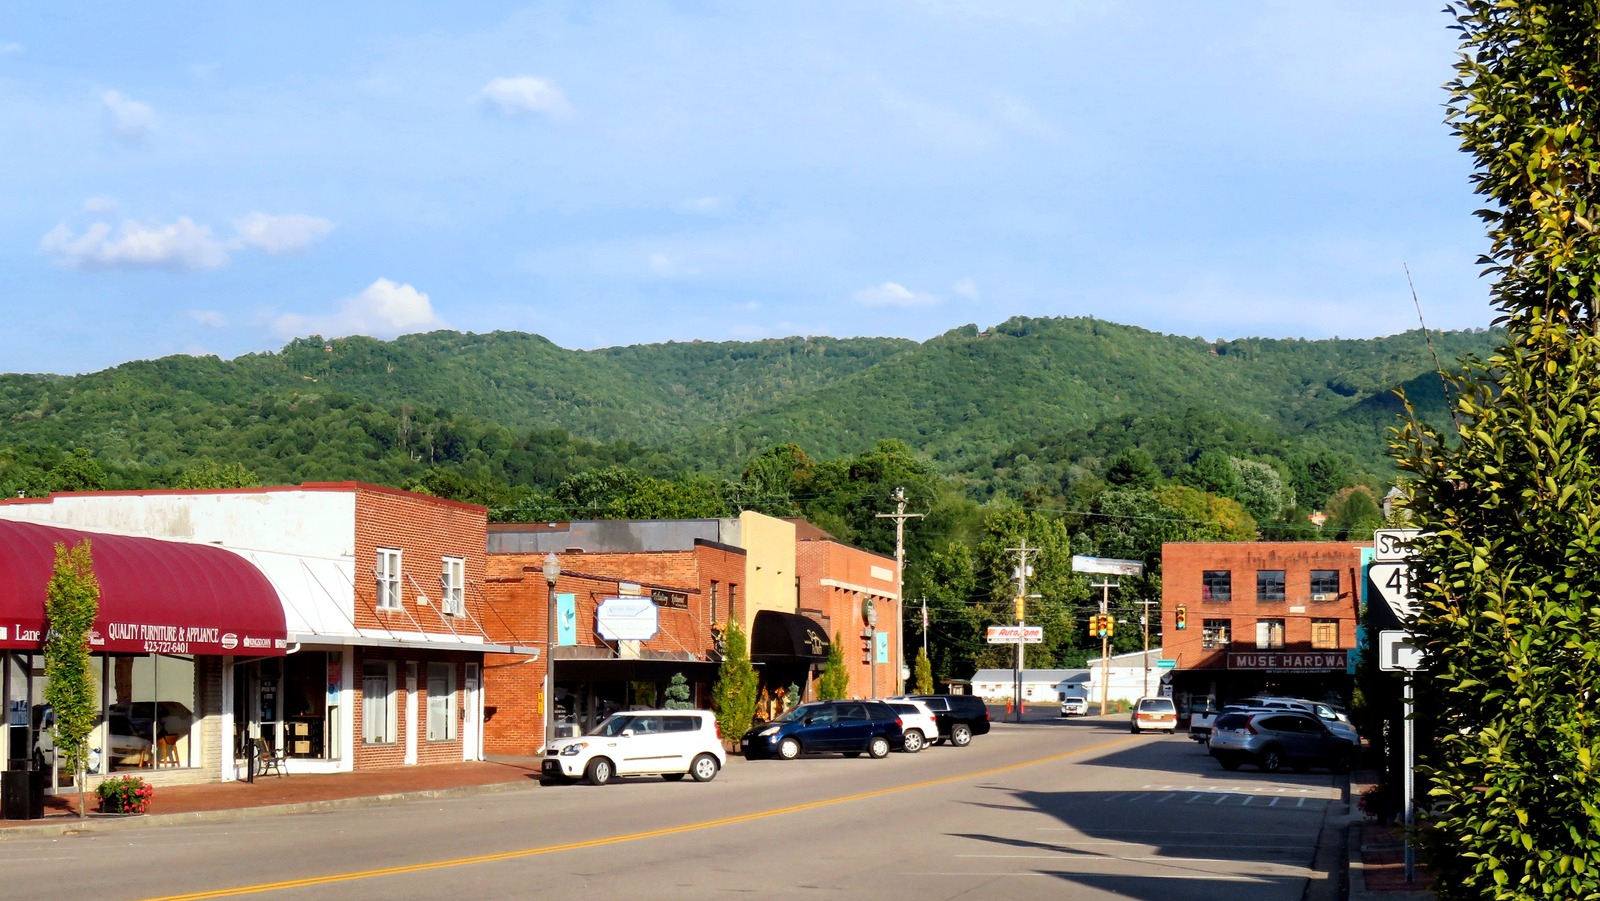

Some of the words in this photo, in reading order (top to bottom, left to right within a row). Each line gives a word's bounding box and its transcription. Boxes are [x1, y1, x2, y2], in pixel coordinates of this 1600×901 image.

[15, 624, 41, 641] Lane
[108, 622, 139, 640] QUALITY
[140, 624, 178, 642] FURNITURE
[178, 626, 186, 642] &
[186, 627, 219, 643] APPLIANCE
[998, 628, 1040, 637] Autoone
[143, 640, 189, 653] 423-727-6401
[1236, 655, 1277, 667] MUSE
[1283, 655, 1345, 667] HARDWA
